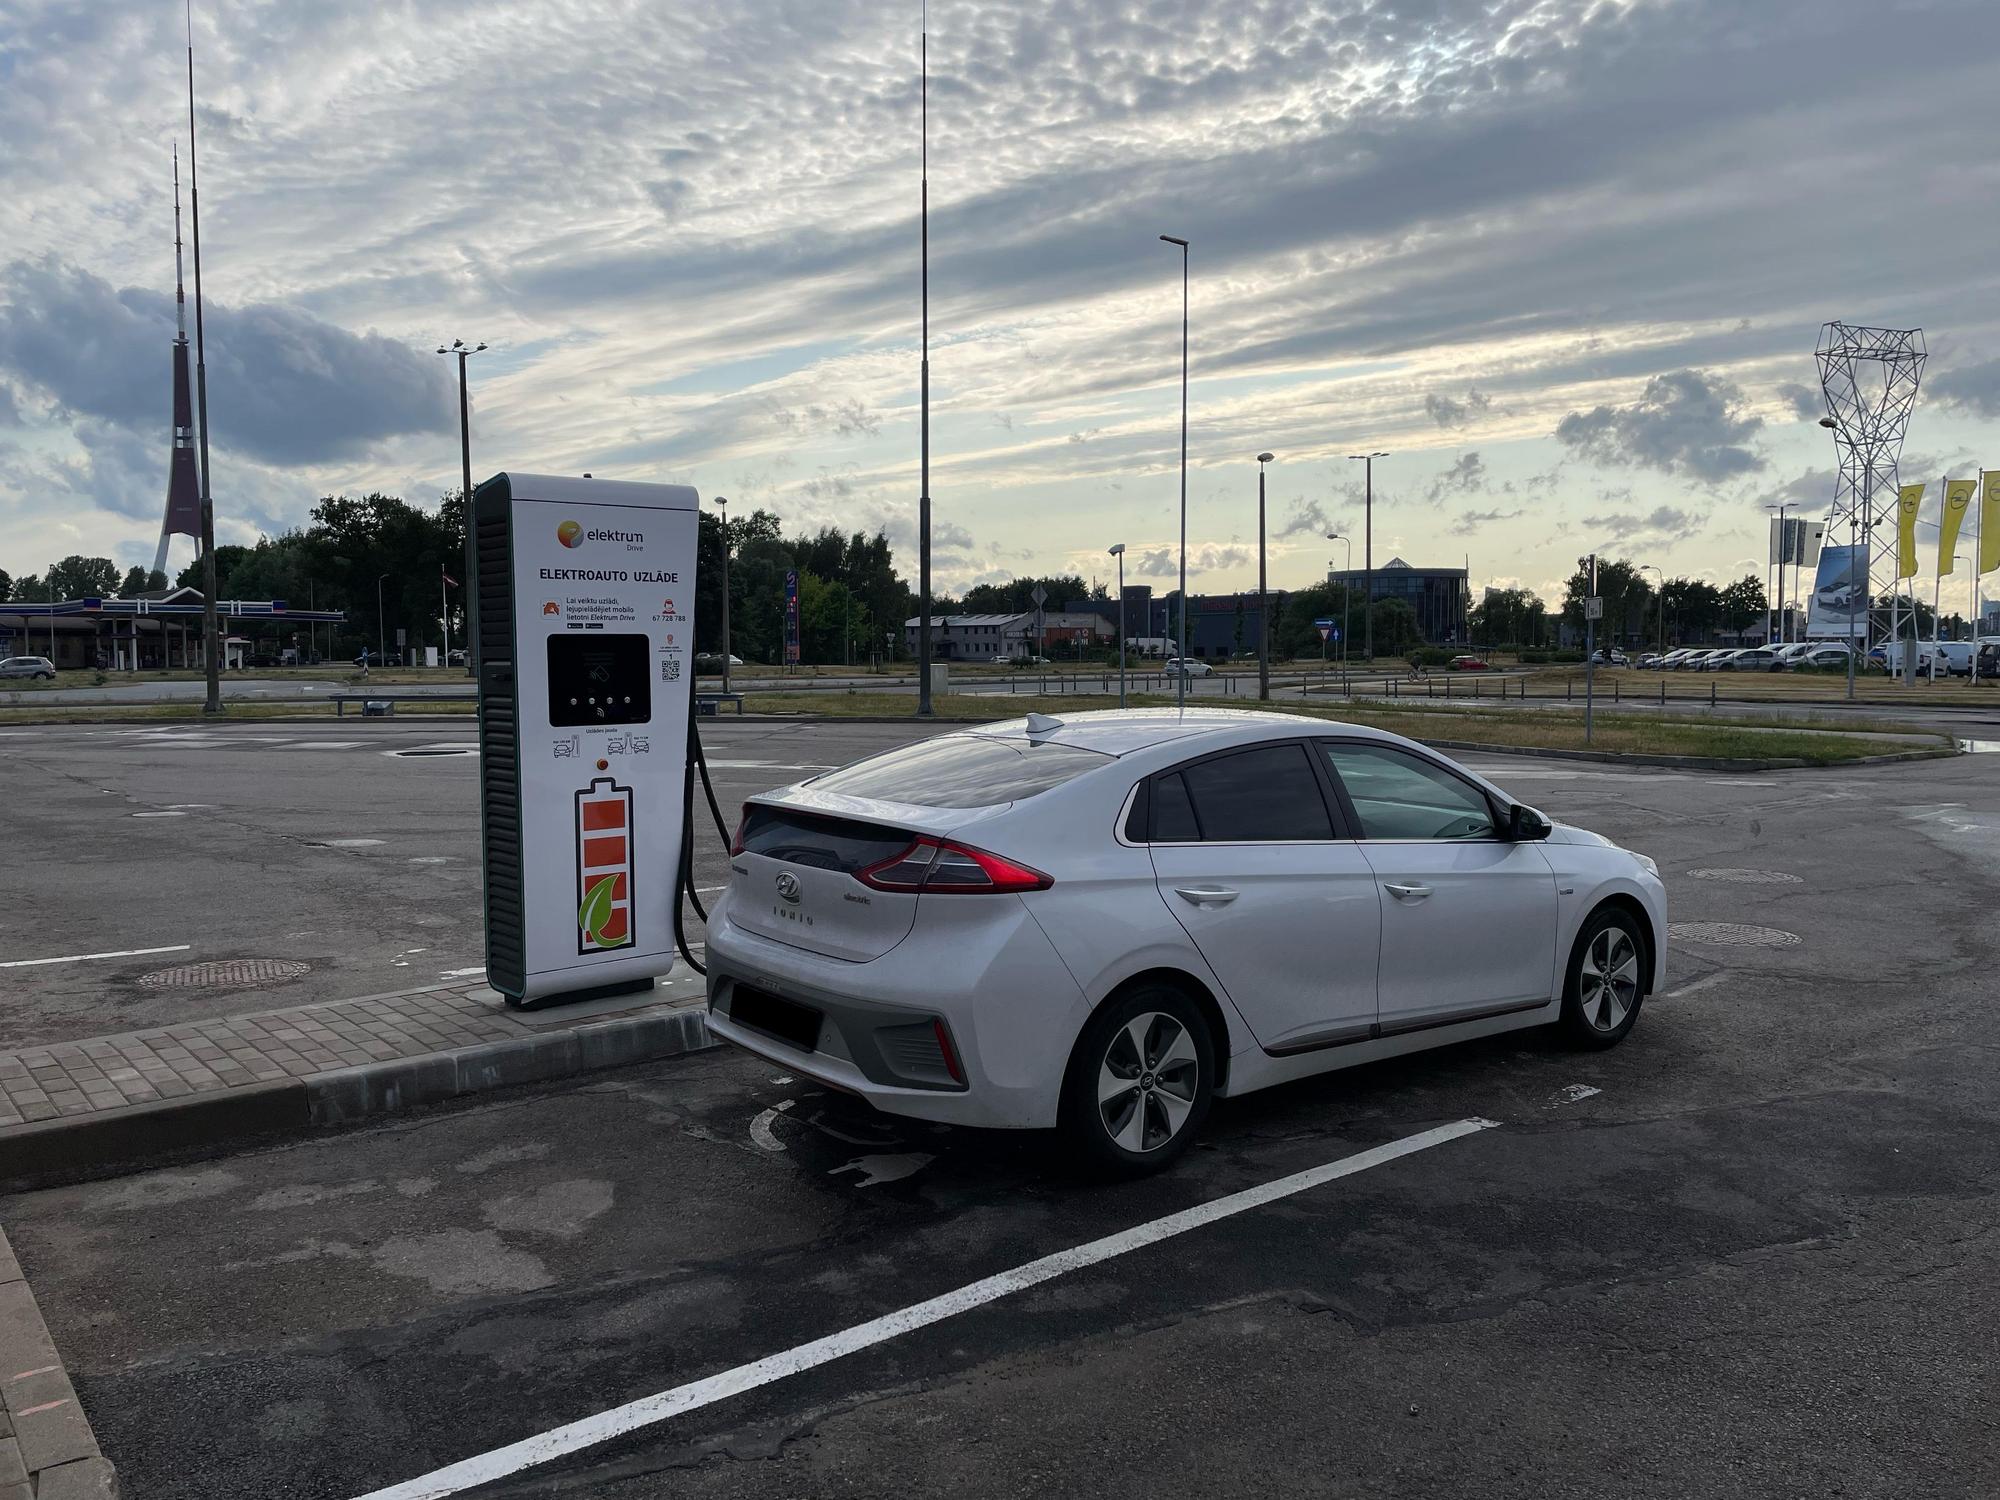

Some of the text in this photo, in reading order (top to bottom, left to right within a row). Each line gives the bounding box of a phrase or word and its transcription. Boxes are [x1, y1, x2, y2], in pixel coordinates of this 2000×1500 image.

[587, 528, 644, 543] elektrum
[626, 544, 644, 552] Drive
[539, 568, 679, 583] ELEKTROAUTO UZLĀDE
[590, 613, 619, 621] Elektrum
